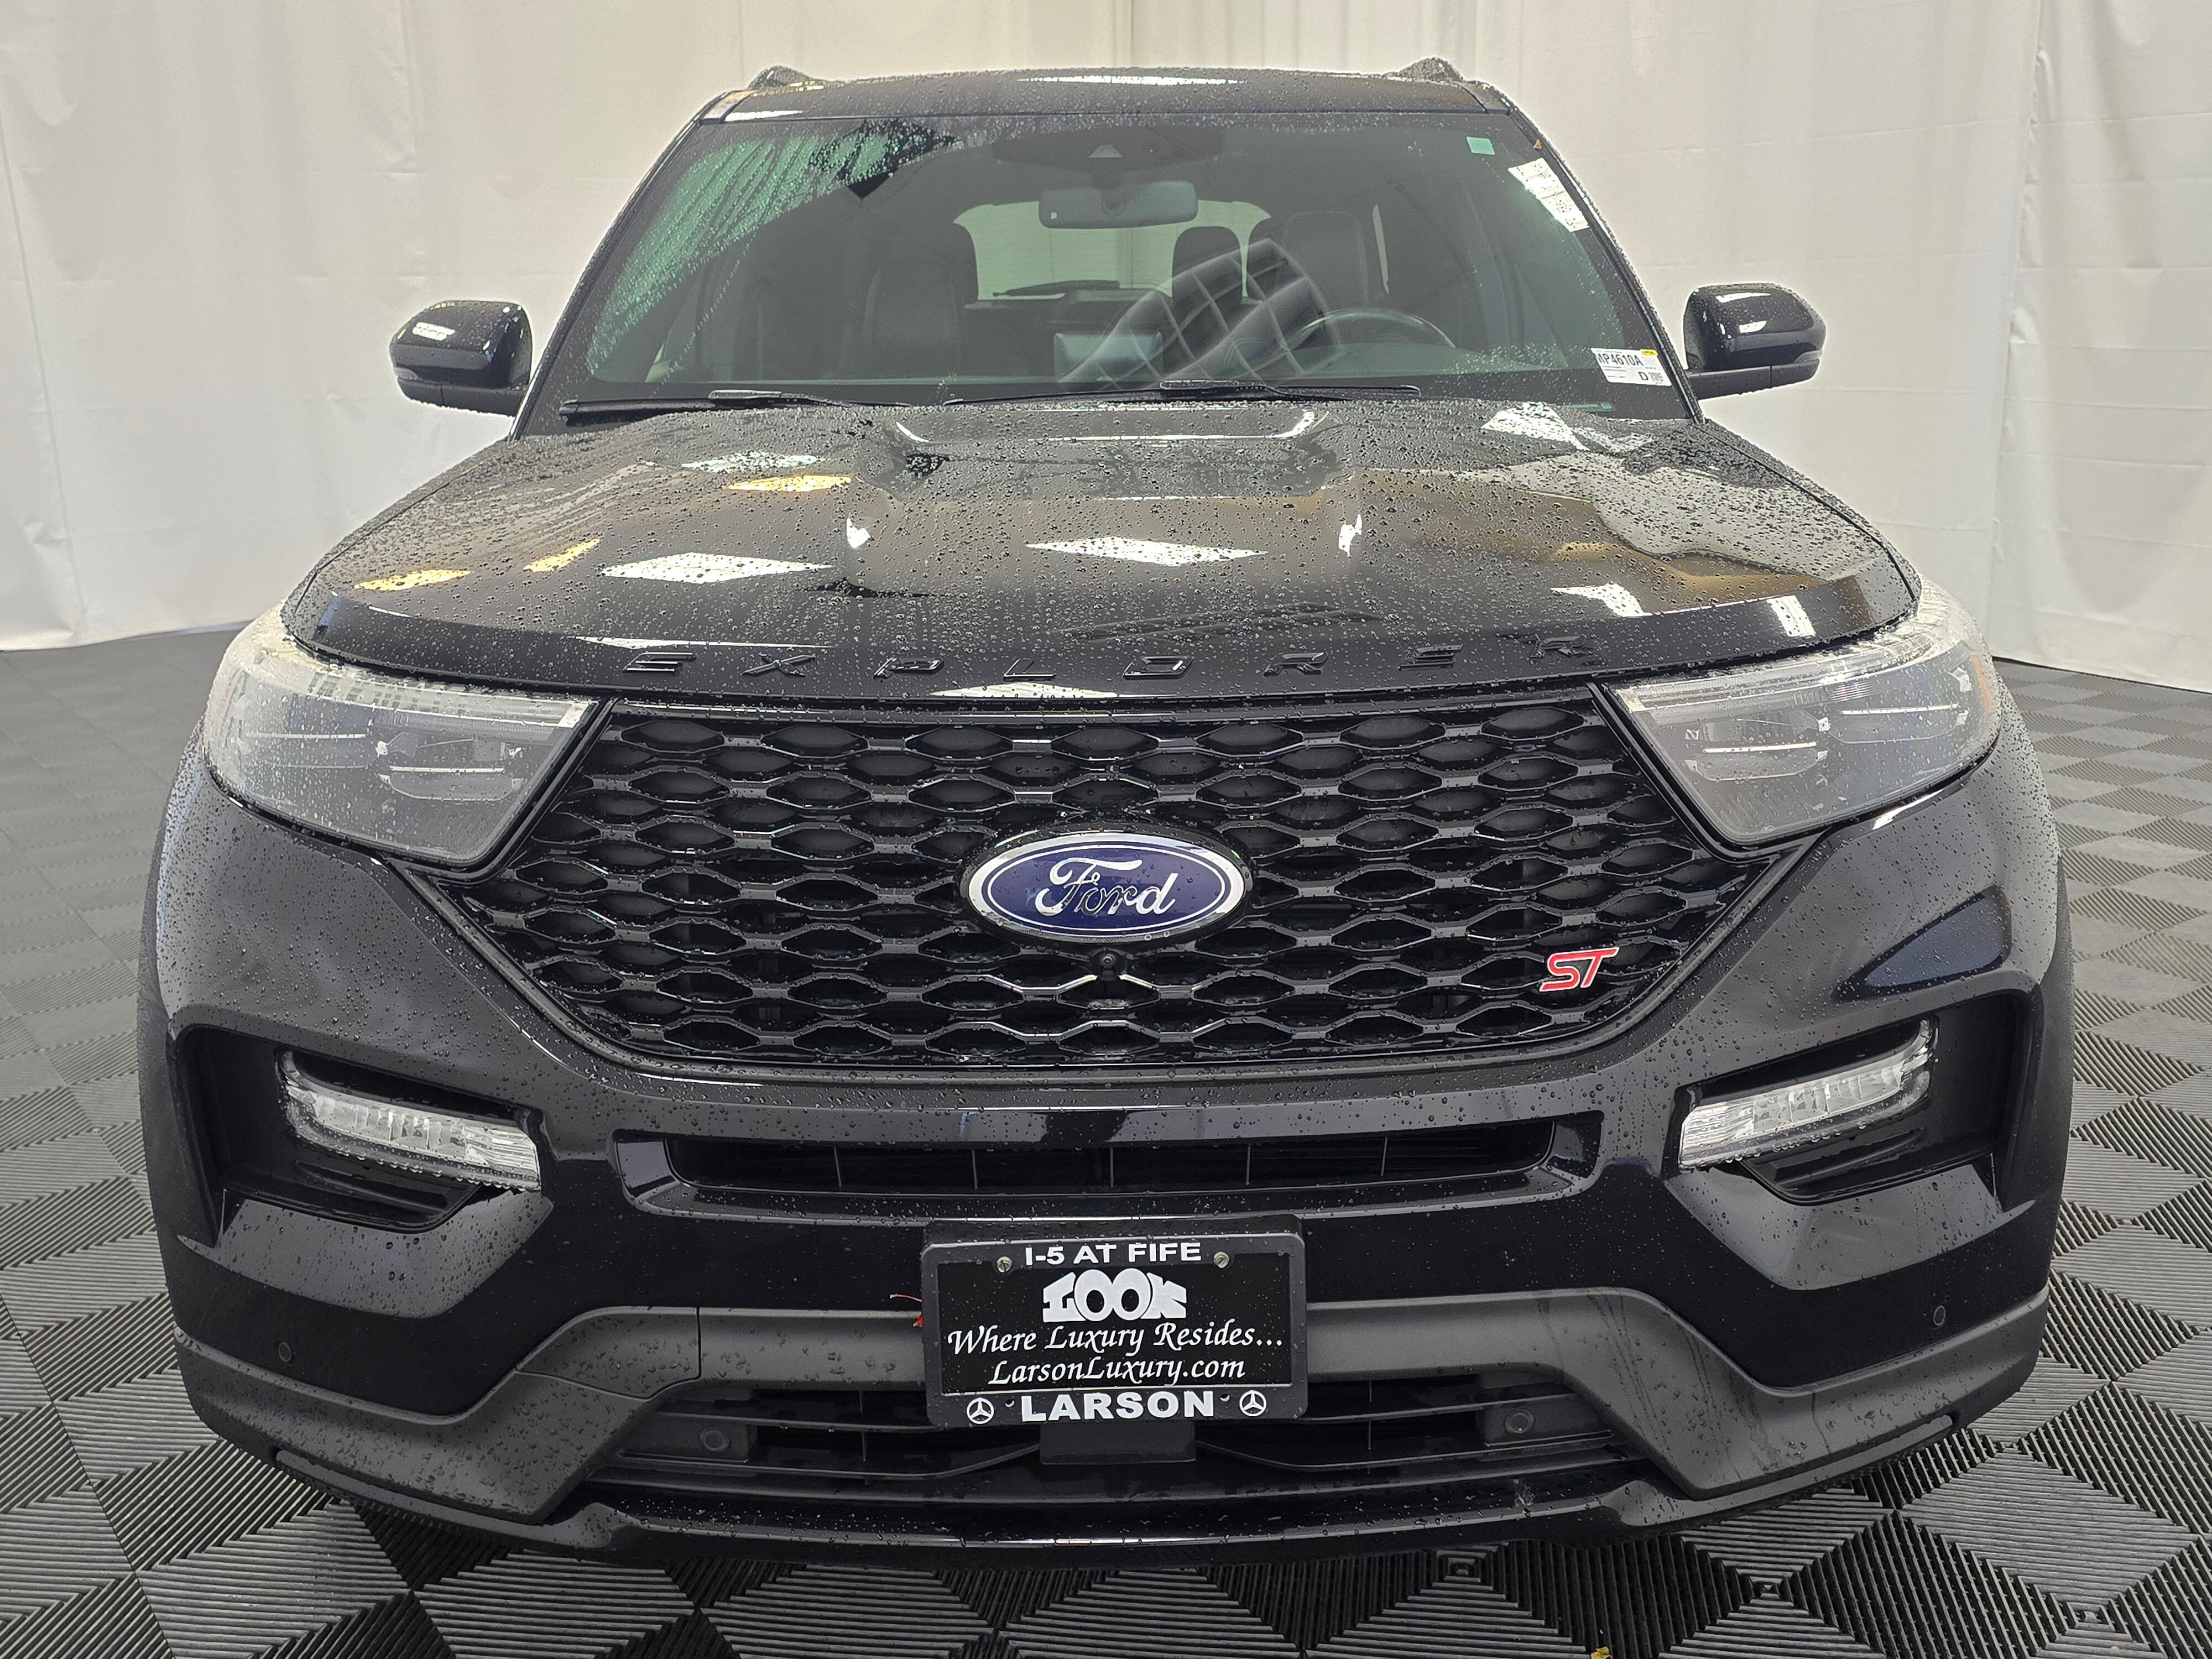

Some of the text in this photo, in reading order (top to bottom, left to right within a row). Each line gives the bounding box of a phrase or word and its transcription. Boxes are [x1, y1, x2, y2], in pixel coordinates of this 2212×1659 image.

[1638, 372, 1648, 380] D
[622, 634, 1593, 680] EXPLORER
[1035, 857, 1179, 916] Ford
[1539, 947, 1620, 992] ST
[1025, 1242, 1202, 1265] I-5 AT FIFE
[1043, 1268, 1187, 1323] LOOK
[948, 1319, 1283, 1357] Where Luxury Resides...
[988, 1356, 1245, 1386] LarsonLuxury.com
[1021, 1390, 1214, 1422] LARSON
